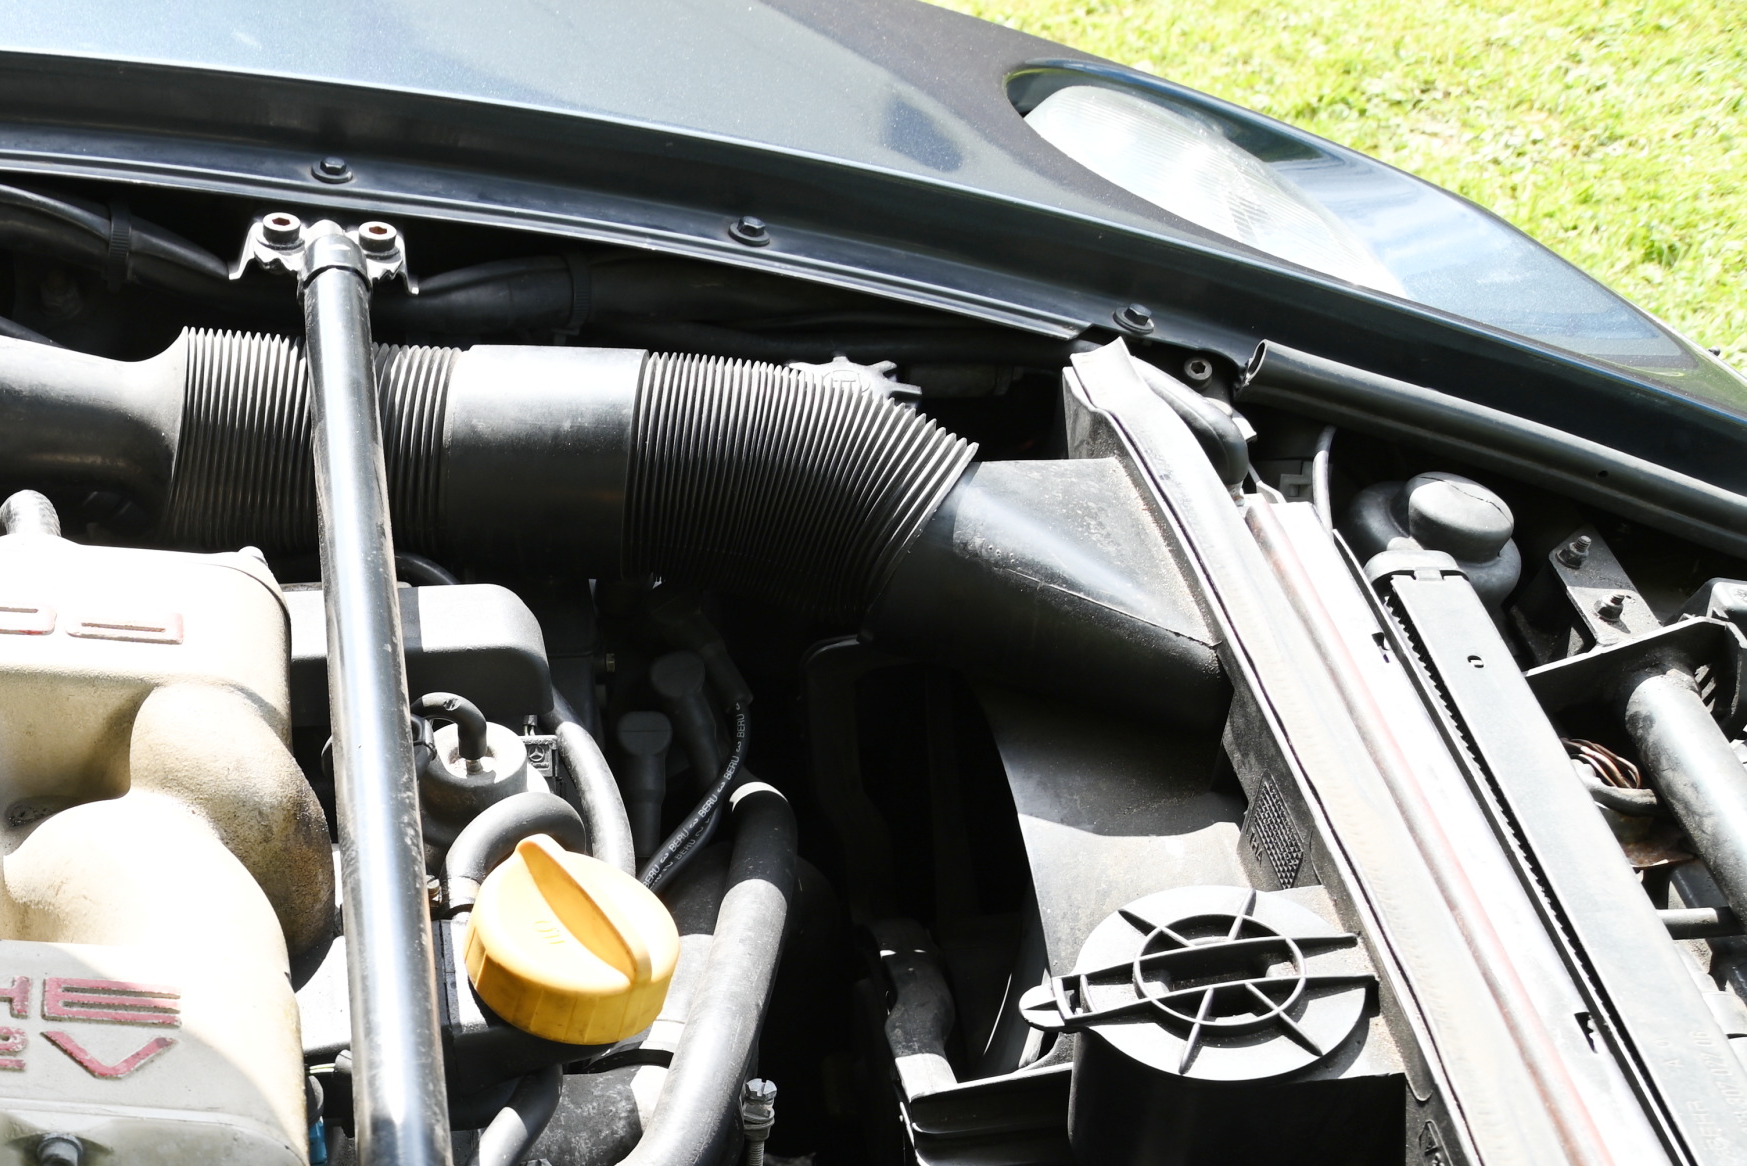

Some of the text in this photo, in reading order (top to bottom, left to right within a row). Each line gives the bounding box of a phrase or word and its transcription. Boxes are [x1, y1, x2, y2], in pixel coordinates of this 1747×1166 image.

[736, 713, 745, 738] BERU
[723, 756, 740, 780] BERU
[697, 793, 718, 818] BERU
[668, 827, 689, 852] BERU
